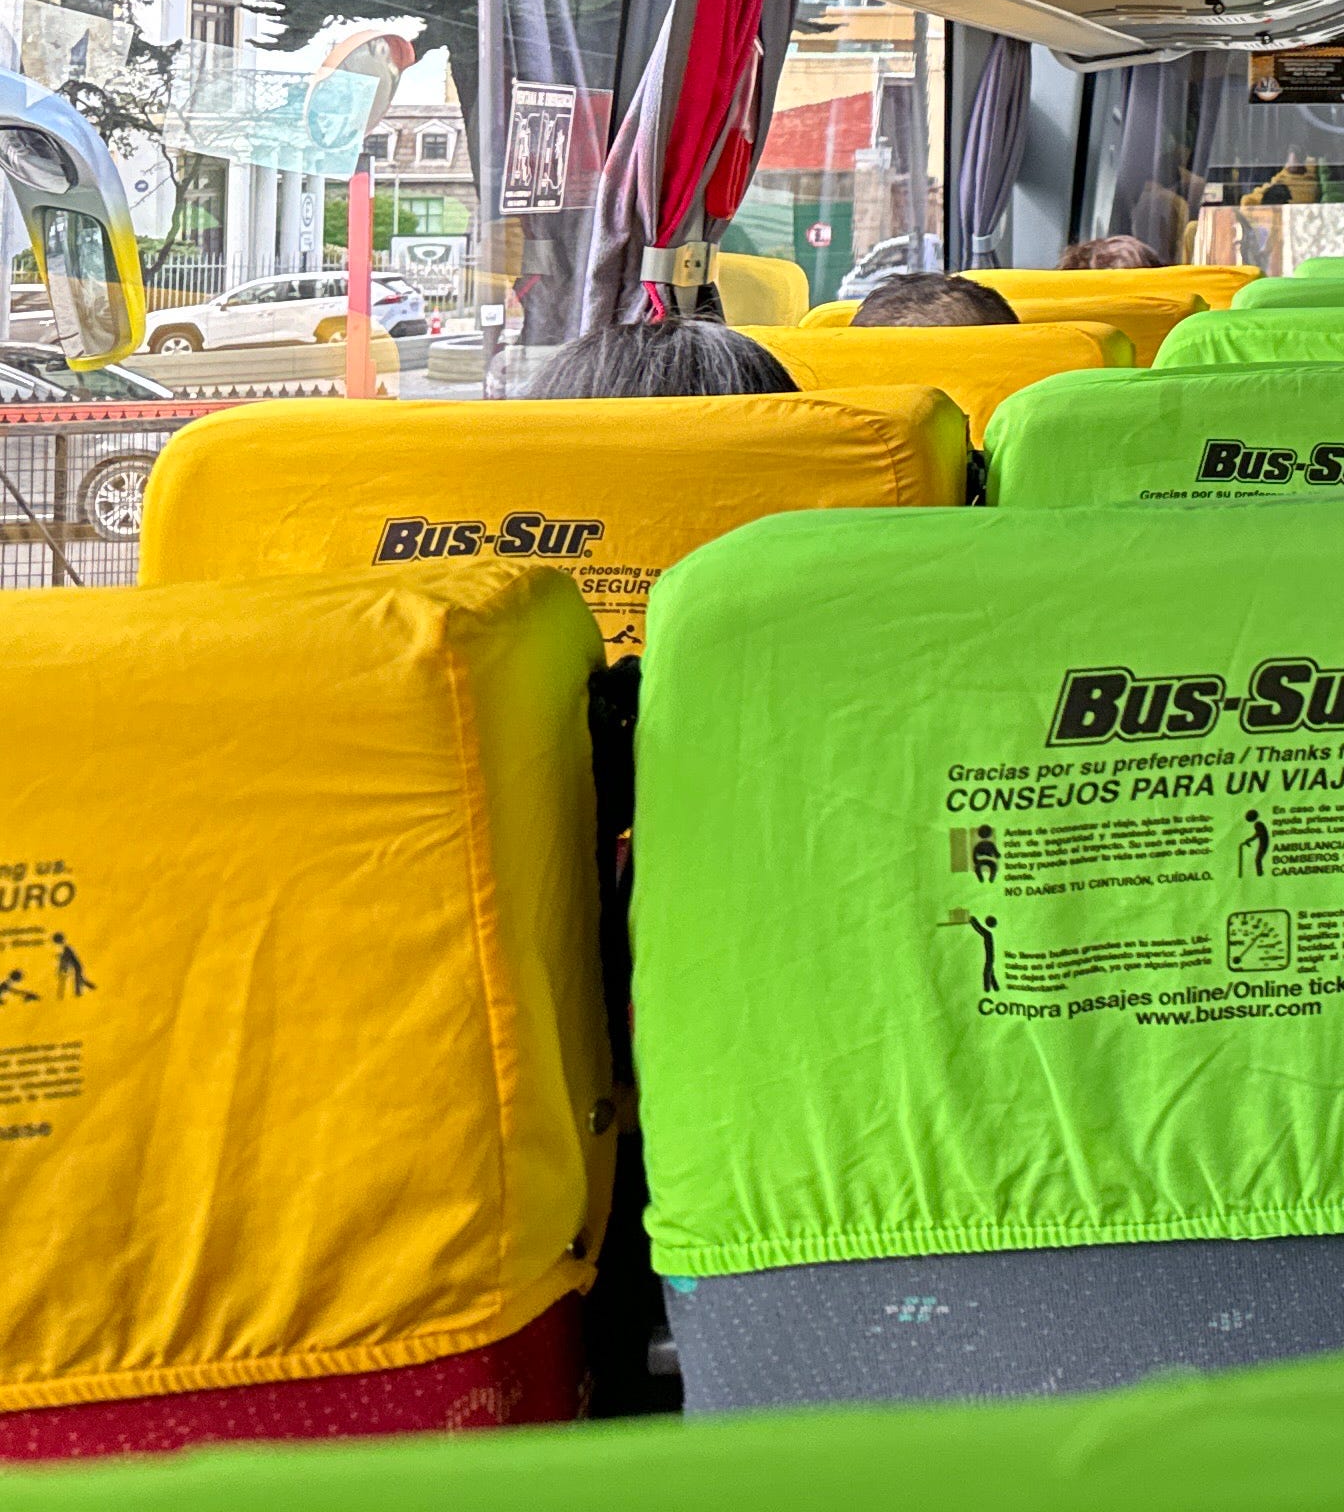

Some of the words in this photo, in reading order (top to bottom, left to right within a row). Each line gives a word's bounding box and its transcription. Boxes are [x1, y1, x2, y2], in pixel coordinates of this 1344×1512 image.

[372, 511, 605, 566] Bus-Sur
[579, 563, 640, 577] choosing
[582, 579, 655, 595] SEGUR
[948, 763, 1030, 782] Gracias
[1037, 761, 1075, 783] por
[1080, 760, 1106, 776] su
[1112, 749, 1236, 776] preferencia
[1256, 744, 1333, 763] Thanks
[946, 788, 1121, 813] CONSEJOS
[1130, 777, 1214, 801] PARA
[1226, 771, 1270, 795] UN
[1272, 852, 1340, 864] BOMBEROS
[0, 881, 75, 912] URO
[1004, 886, 1022, 897] NO
[1025, 882, 1066, 897] DAÑES
[1070, 881, 1085, 892] TU
[1088, 874, 1154, 890] CINTURÓN,
[977, 997, 1061, 1021] Compra
[1067, 989, 1153, 1019] pasajes
[1158, 980, 1302, 1006] online/Online
[1136, 999, 1322, 1026] www.bussur.com
